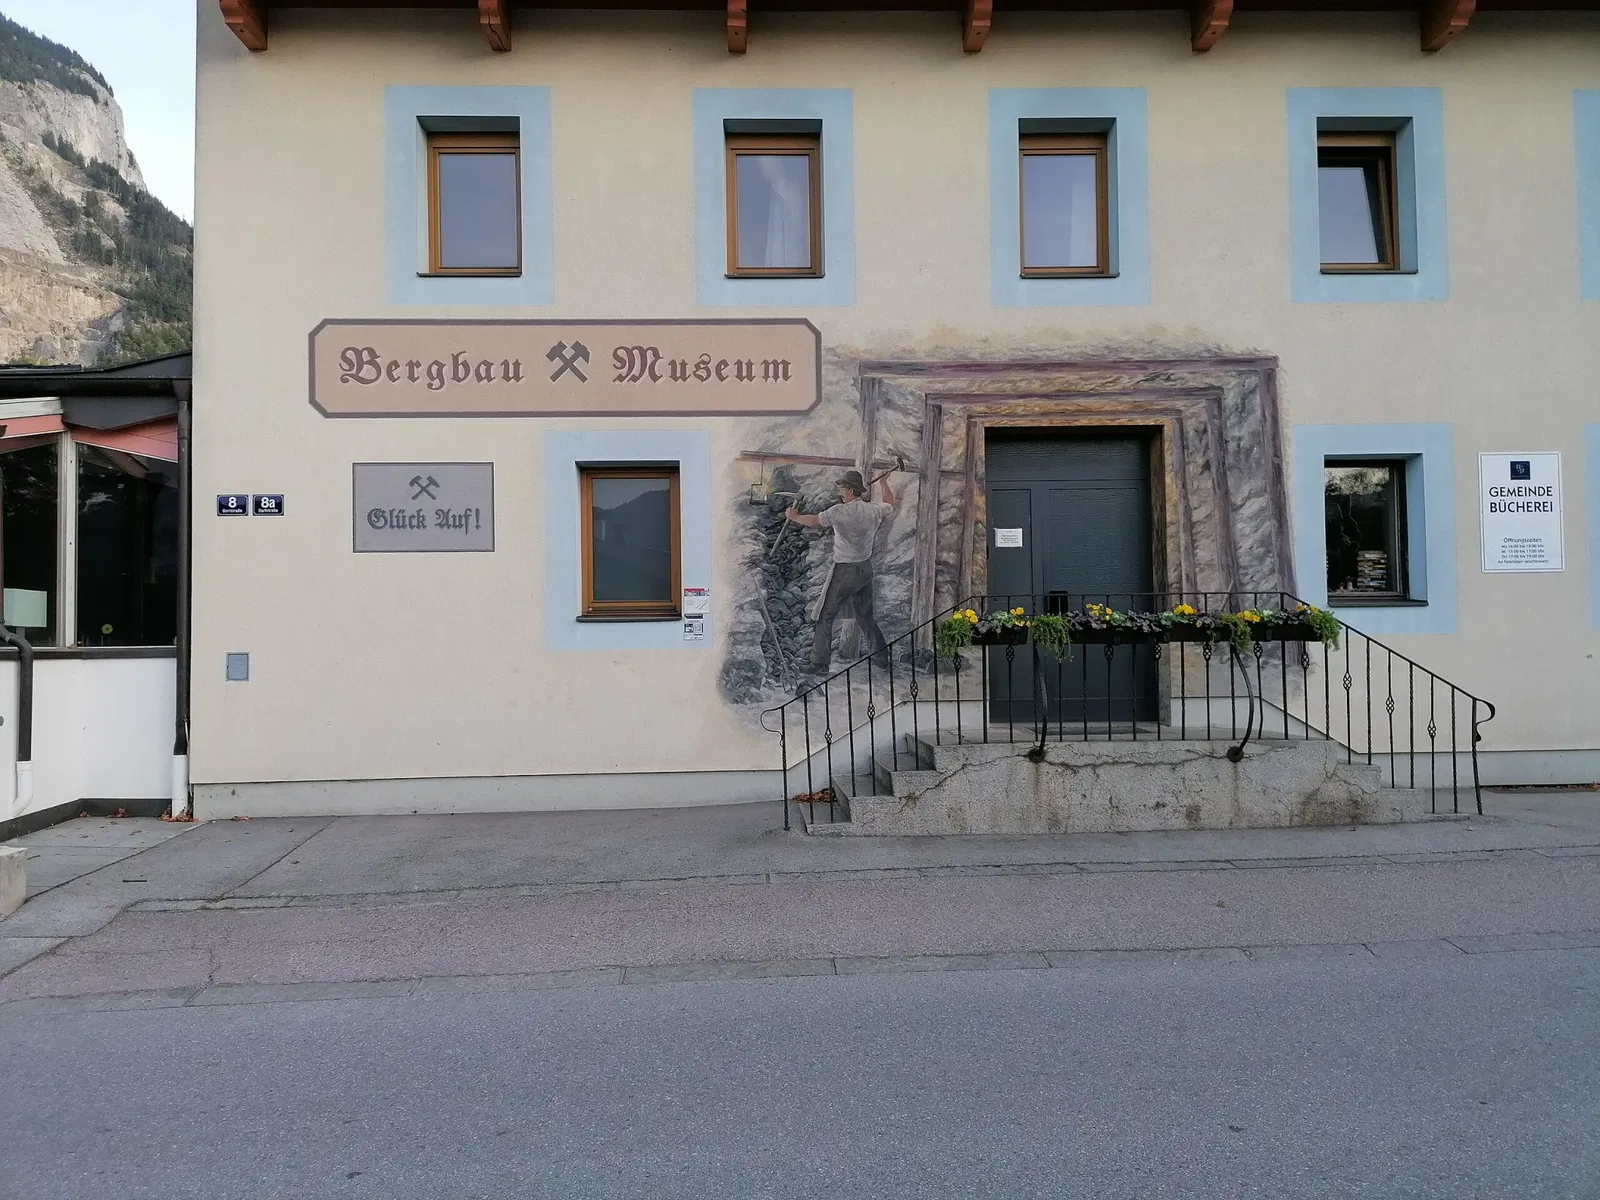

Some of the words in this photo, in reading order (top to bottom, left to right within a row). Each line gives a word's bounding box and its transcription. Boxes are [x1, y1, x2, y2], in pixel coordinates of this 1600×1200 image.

[338, 346, 525, 391] Bergbau
[611, 345, 793, 384] Museum
[1489, 486, 1553, 497] GEMEINDE
[228, 497, 237, 508] 8
[261, 497, 275, 508] 8a
[1490, 499, 1553, 512] BÜCHEREI
[367, 508, 427, 530] Glück
[434, 508, 481, 535] Auf!
